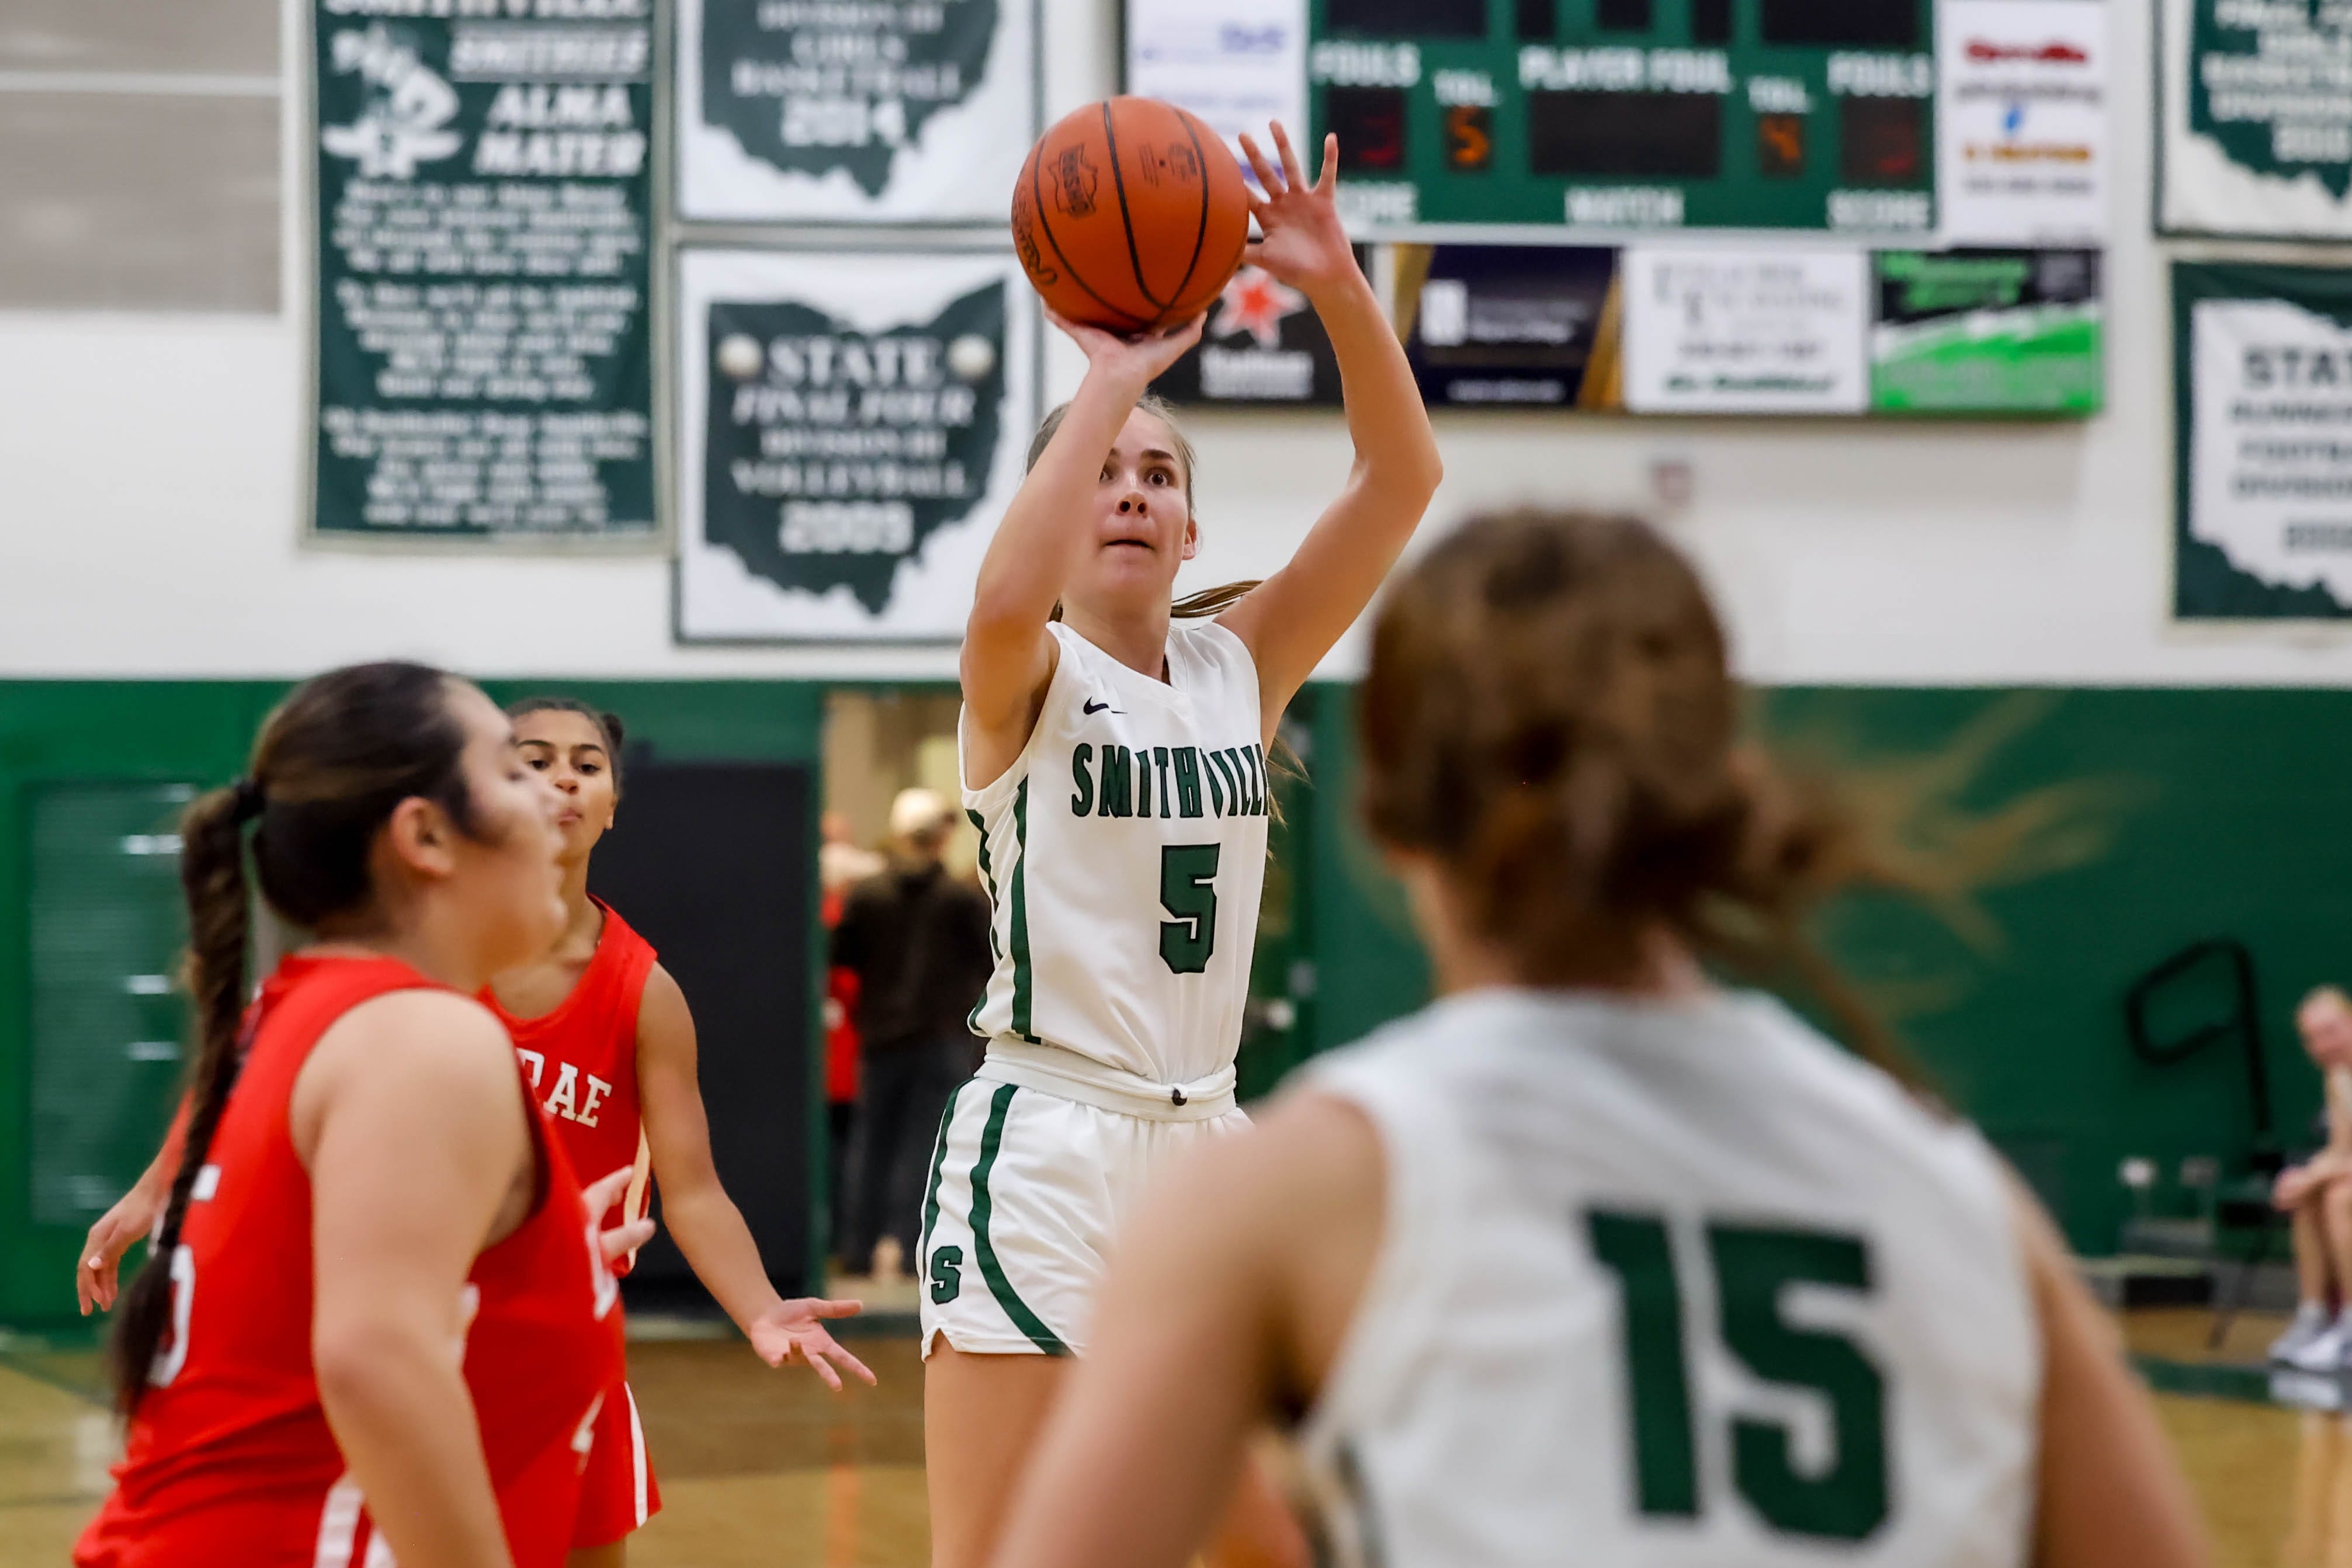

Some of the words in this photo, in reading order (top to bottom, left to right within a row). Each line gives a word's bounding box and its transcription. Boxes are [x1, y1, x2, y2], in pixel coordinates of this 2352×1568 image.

[1313, 43, 1420, 86] FOULS
[1520, 47, 1643, 91] PLAYER
[1649, 49, 1733, 92] FOUL
[1826, 53, 1931, 96] FOULS
[488, 85, 633, 125] ALMA
[472, 132, 647, 174] MATER
[1448, 106, 1489, 165] 5
[1564, 186, 1685, 224] MATCH
[768, 339, 942, 386] STATE
[1160, 842, 1220, 974] 5
[931, 1246, 963, 1305] S
[1581, 1203, 1890, 1541] 15
